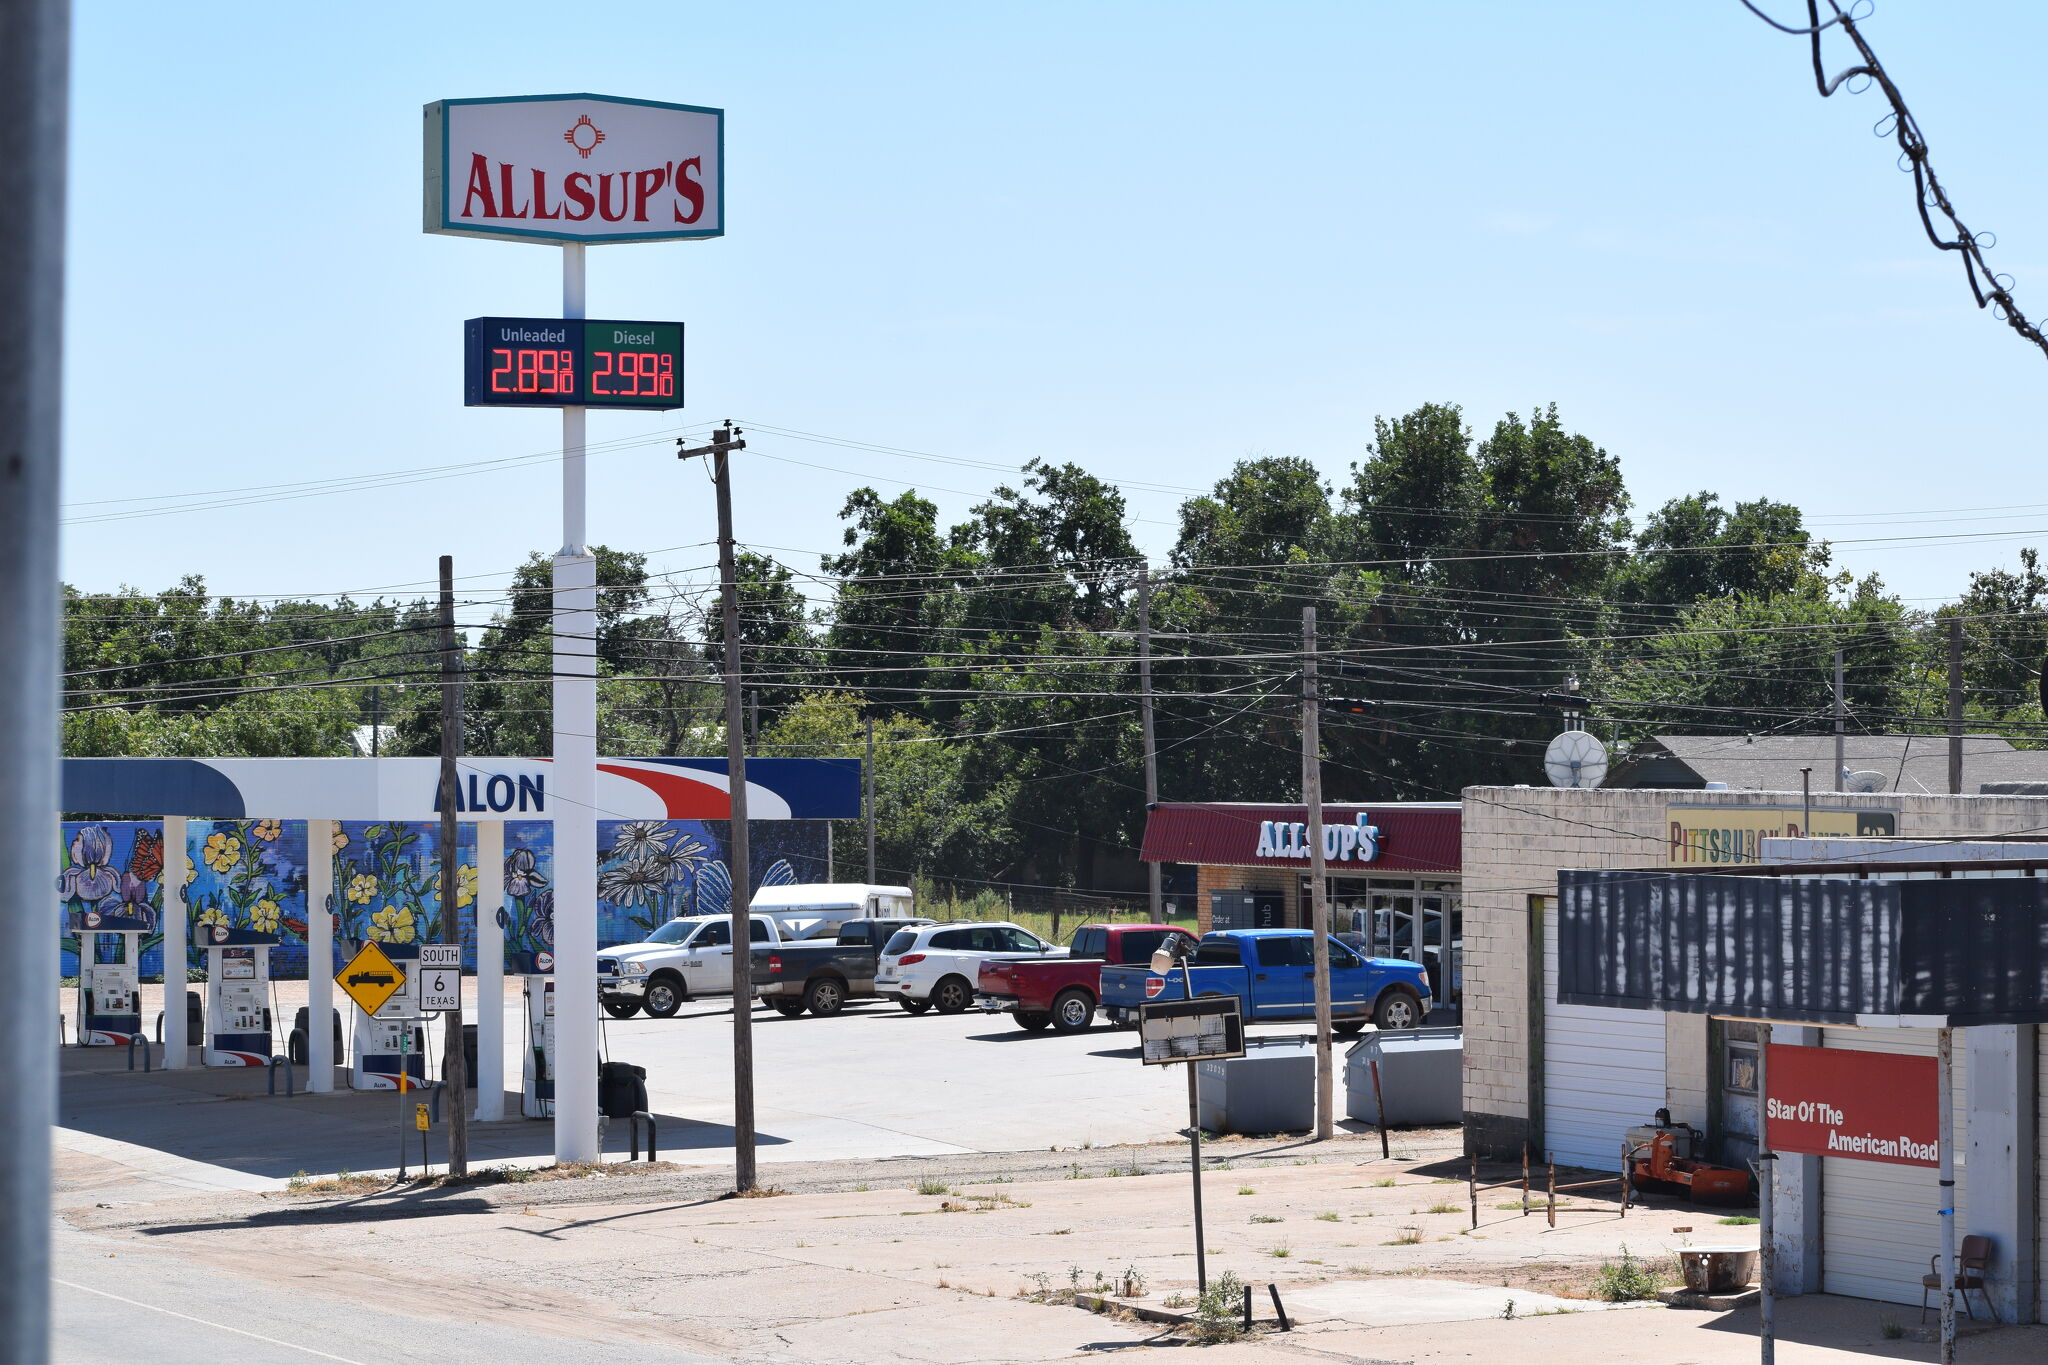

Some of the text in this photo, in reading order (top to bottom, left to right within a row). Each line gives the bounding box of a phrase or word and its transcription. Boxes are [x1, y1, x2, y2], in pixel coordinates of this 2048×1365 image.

[461, 152, 705, 225] ALLSUP'S
[501, 327, 566, 343] Unleaded
[613, 330, 655, 346] Diesel
[433, 770, 545, 812] ALON
[1670, 821, 1779, 864] PITTSBUR
[422, 949, 459, 962] SOUTH
[434, 974, 446, 992] 6
[425, 996, 455, 1005] TEXAS
[1767, 1097, 1844, 1126] Star Of The
[1828, 1129, 1938, 1162] American Road
